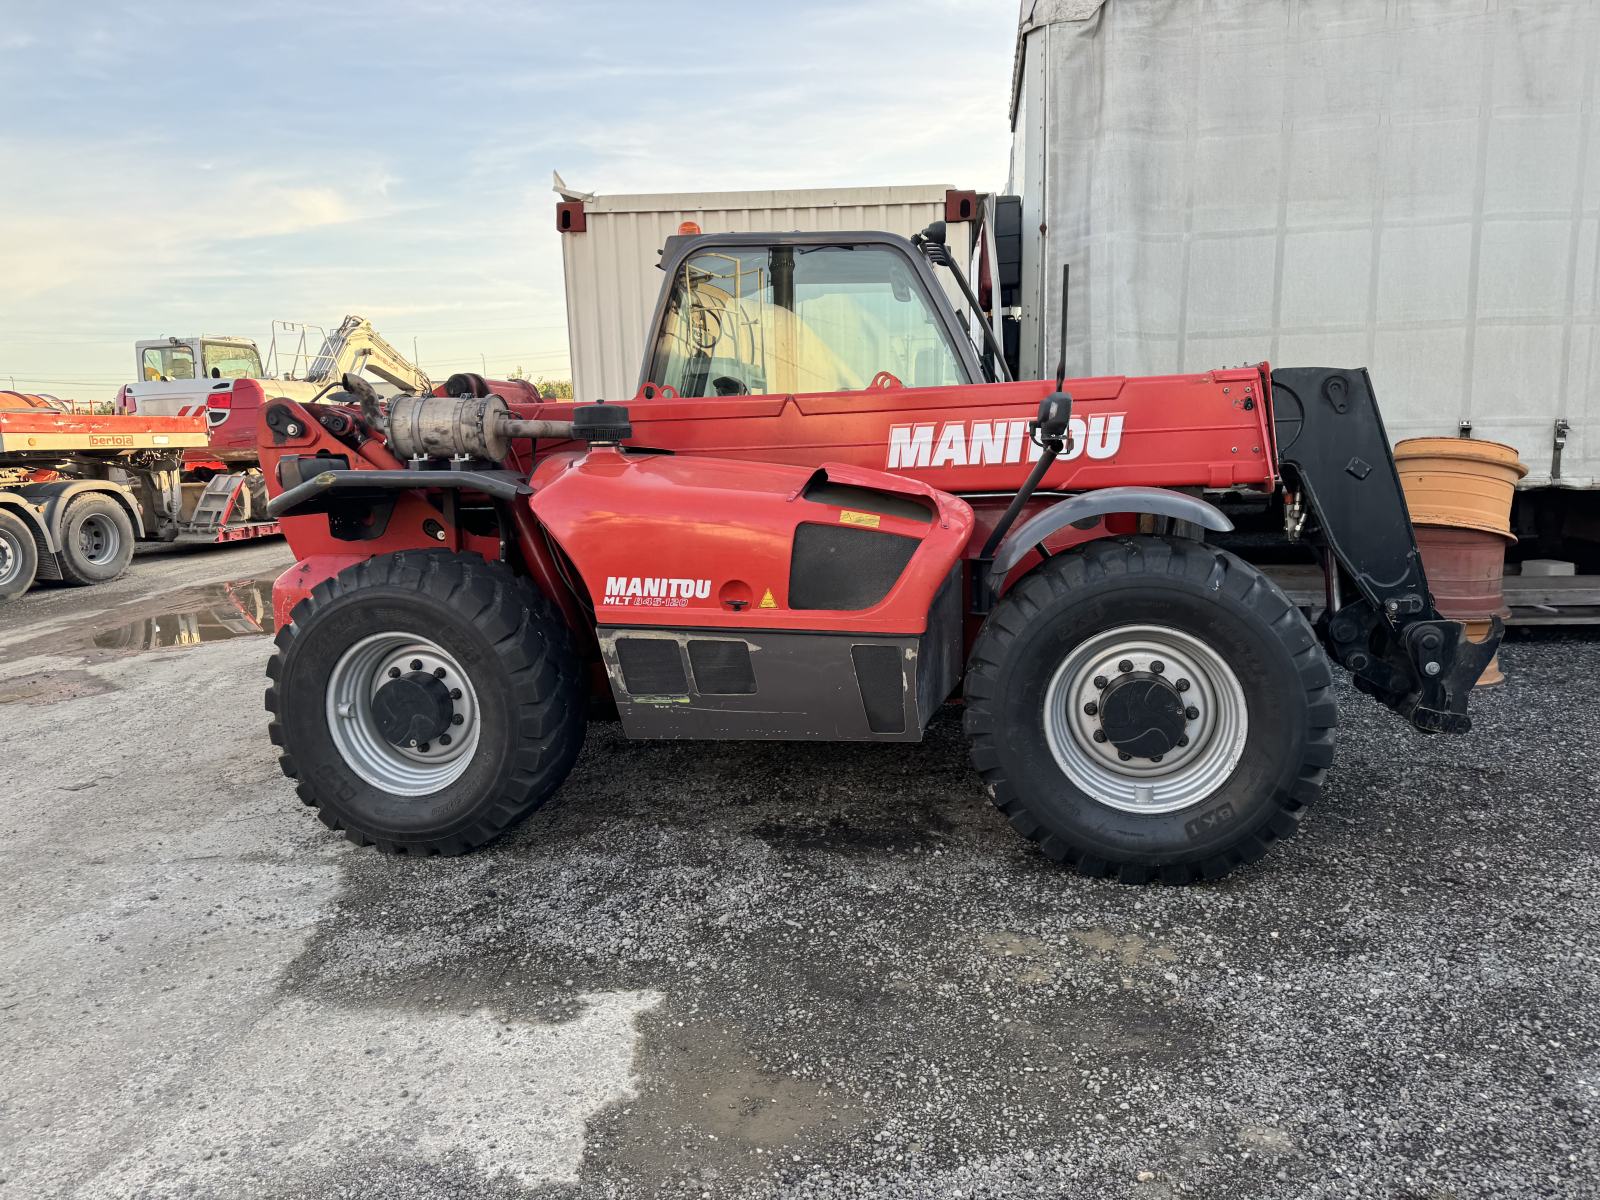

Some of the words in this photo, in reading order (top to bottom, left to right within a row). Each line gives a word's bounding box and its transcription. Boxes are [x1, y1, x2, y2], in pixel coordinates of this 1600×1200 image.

[605, 576, 712, 599] MANITOU
[603, 597, 632, 606] MLT
[633, 598, 689, 607] 845-120
